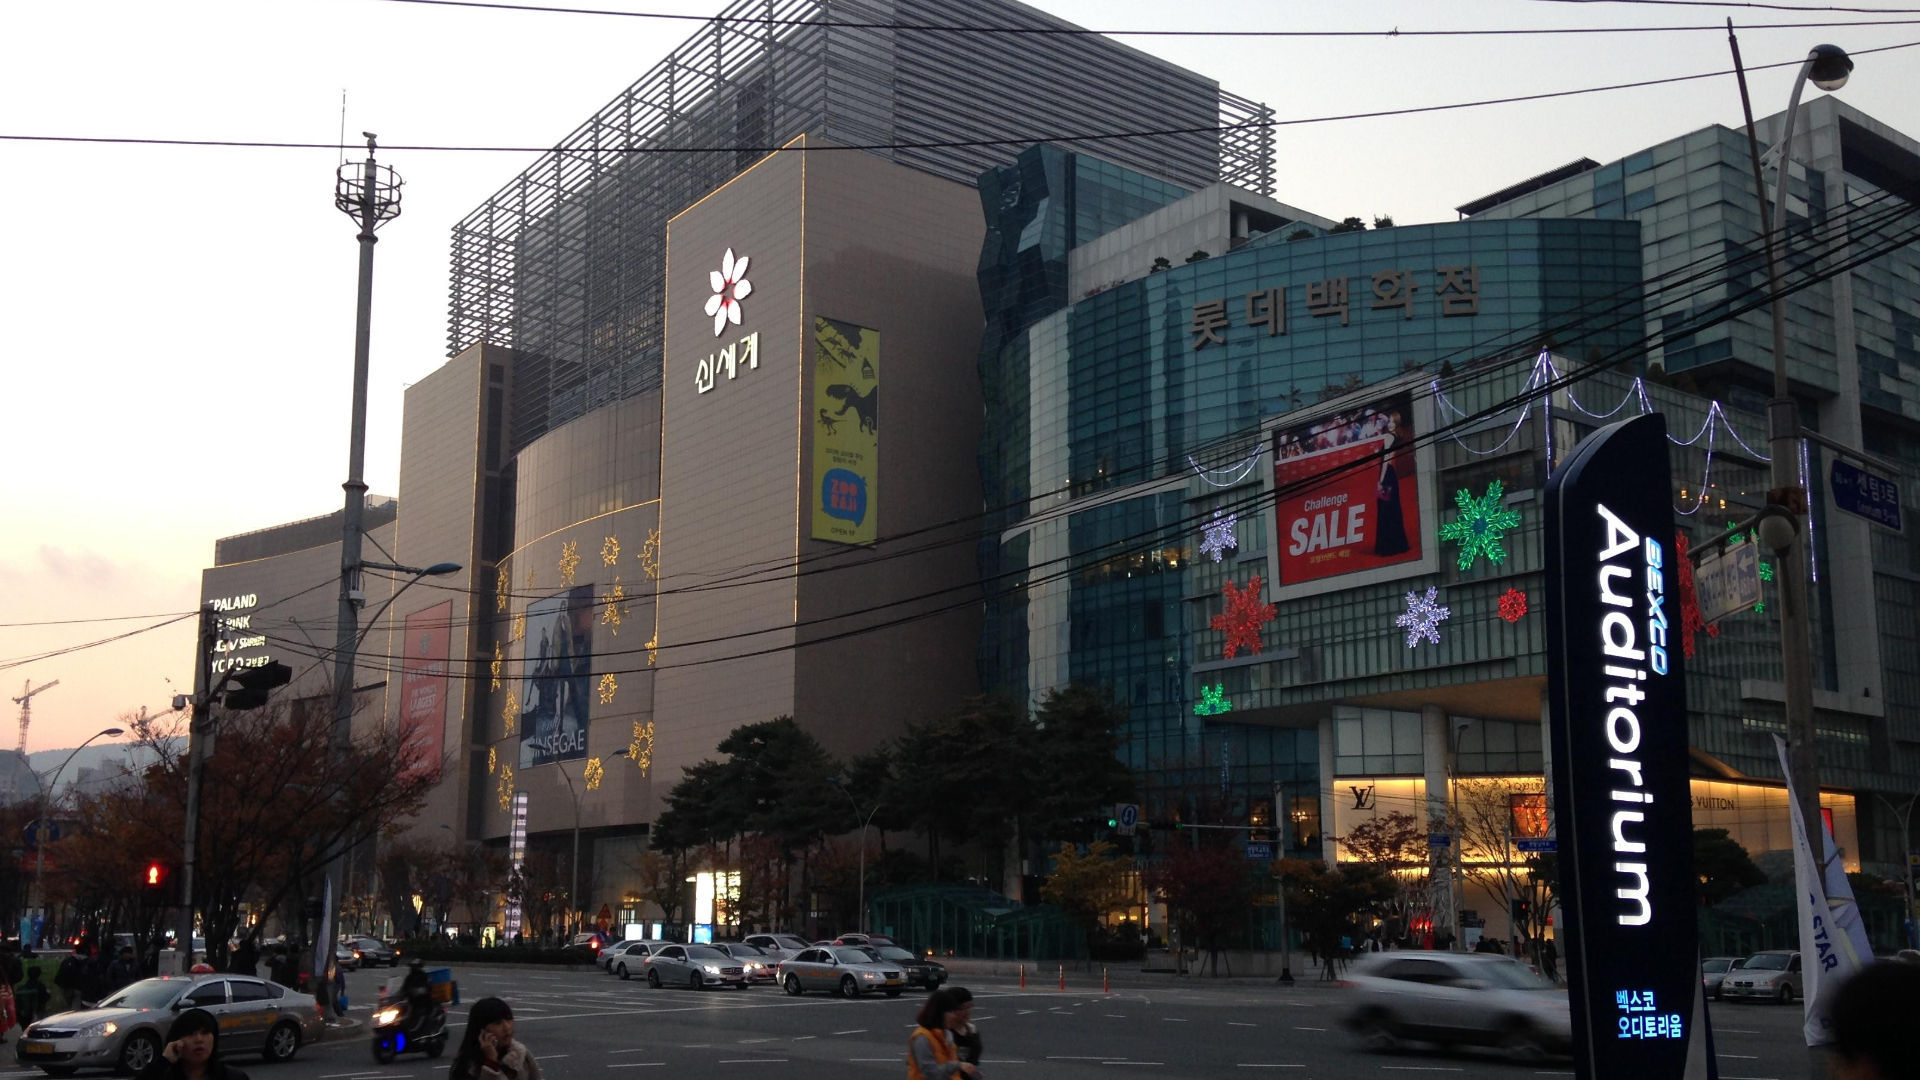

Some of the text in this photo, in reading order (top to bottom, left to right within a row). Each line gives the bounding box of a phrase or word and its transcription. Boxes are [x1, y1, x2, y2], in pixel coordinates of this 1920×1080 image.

[1189, 263, 1480, 350] 롯데백화점
[695, 332, 759, 394] 신세계
[1304, 492, 1348, 512] Challenge
[1289, 503, 1365, 556] SALE
[209, 593, 257, 612] PALAND
[1645, 536, 1669, 676] BEXCO
[1597, 503, 1654, 926] Auditorium
[1696, 796, 1735, 810] VUITTON
[1616, 989, 1657, 1014] 벡스코
[1617, 1014, 1683, 1040] 오디토리움
